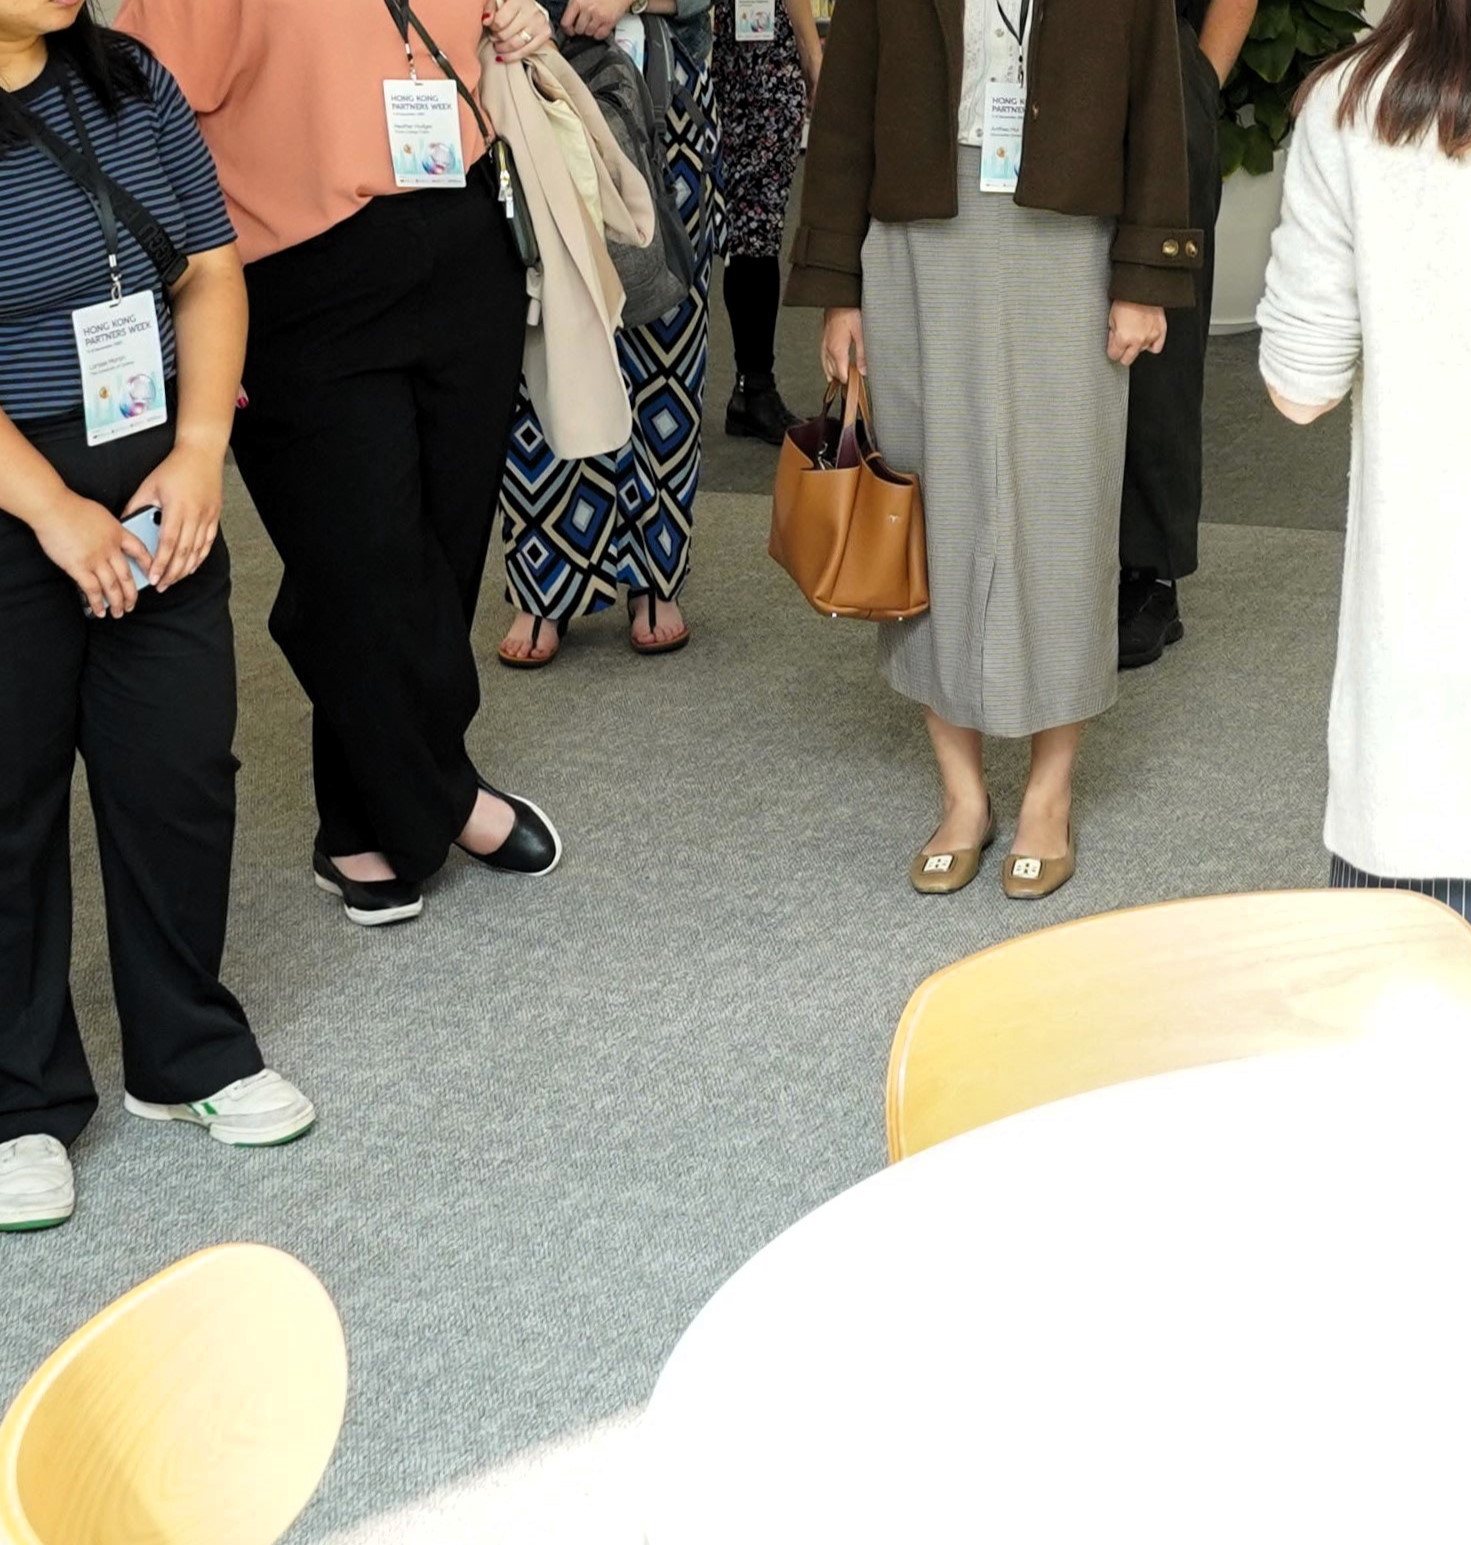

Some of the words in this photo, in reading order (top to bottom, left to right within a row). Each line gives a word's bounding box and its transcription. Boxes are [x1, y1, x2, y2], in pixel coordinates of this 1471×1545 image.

[392, 103, 429, 111] PARTNERS
[992, 97, 1017, 105] HONG
[83, 321, 110, 337] HONG
[111, 314, 137, 328] KONG
[84, 329, 127, 347] PARTNERS
[128, 319, 152, 335] WEEK
